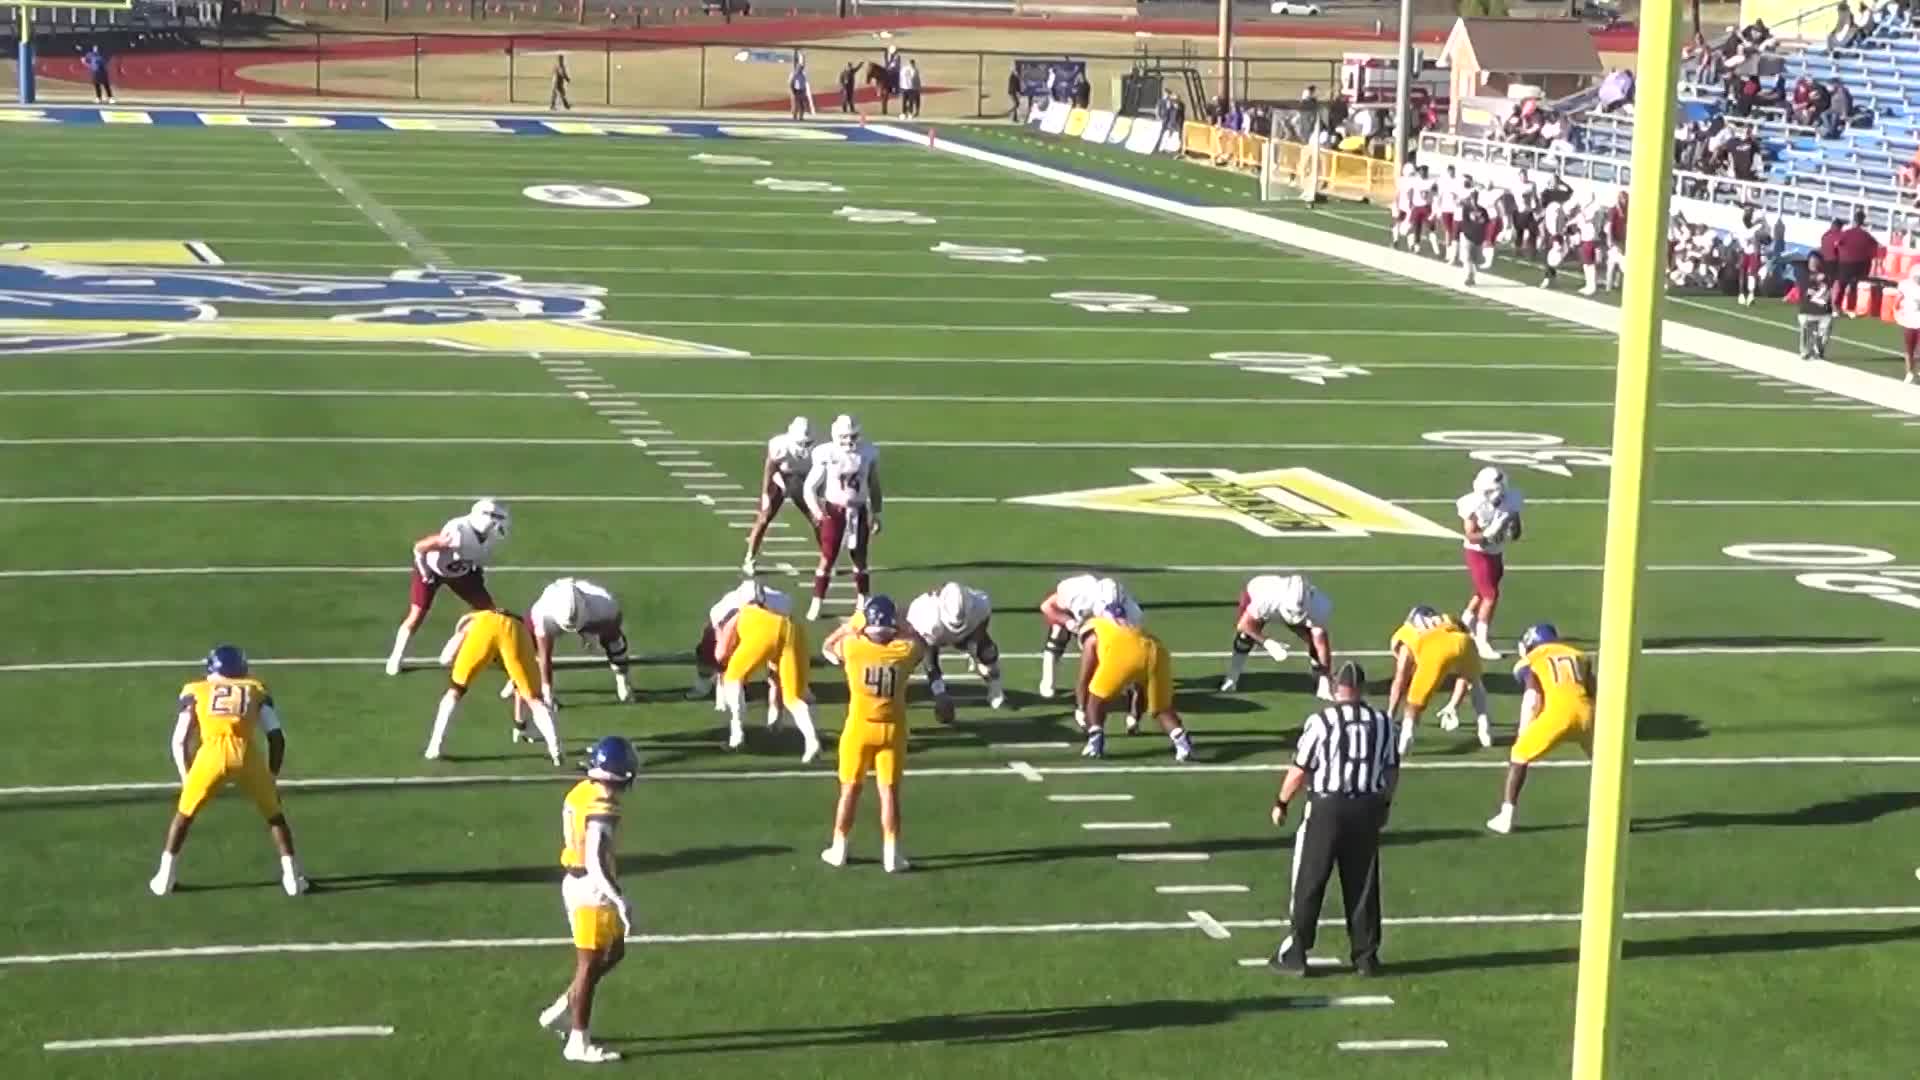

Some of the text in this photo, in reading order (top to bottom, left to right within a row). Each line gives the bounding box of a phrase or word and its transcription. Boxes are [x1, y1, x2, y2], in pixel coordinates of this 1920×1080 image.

[838, 471, 860, 492] 14
[864, 666, 897, 697] 41
[1545, 655, 1583, 684] 17
[211, 684, 248, 715] 21
